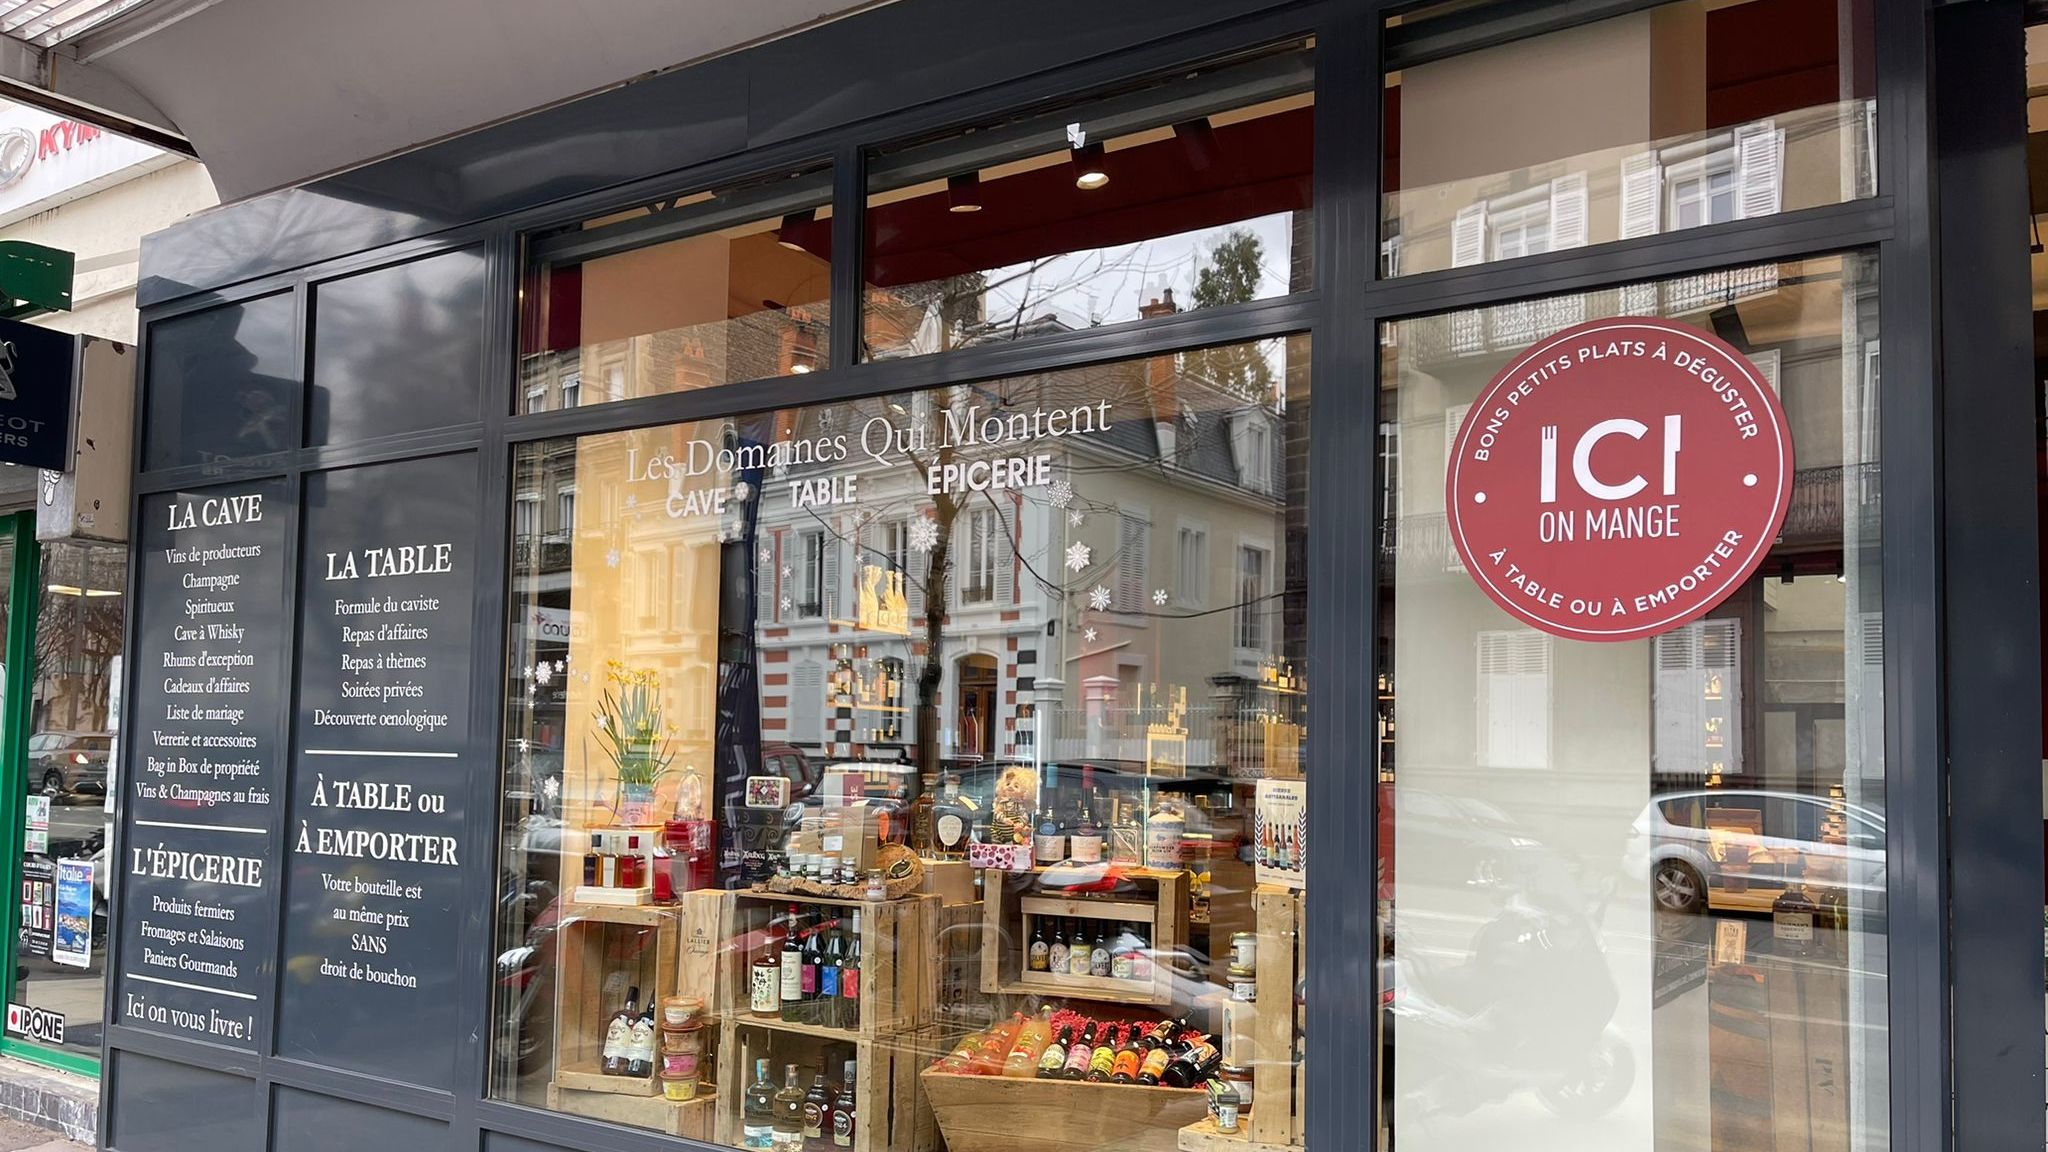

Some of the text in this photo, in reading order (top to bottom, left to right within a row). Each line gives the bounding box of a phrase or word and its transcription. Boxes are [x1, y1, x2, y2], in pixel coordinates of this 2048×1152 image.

[1474, 341, 1758, 462] BONS PETITS PLATS À DÉGUSTER
[626, 398, 1113, 483] Les Domaines Qui Montent
[1540, 414, 1682, 504] ICI
[666, 454, 1051, 518] CAVE TABLE ÉPICERIE
[168, 494, 262, 530] LA CAVE
[1540, 504, 1681, 543] ON MANGE
[166, 544, 261, 566] Vins de producteurs
[325, 543, 452, 580] LA TABLE
[183, 573, 240, 592] Champagne
[1489, 529, 1744, 616] À TABLE OU À EMPORTER
[185, 598, 235, 619] Spiritueux
[335, 594, 439, 616] Formule du caviste
[174, 623, 245, 644] Cave à Whisky
[342, 623, 428, 647] Repas d'affaires
[163, 650, 254, 671] Rhums d'exception
[341, 652, 427, 675] Repas à thèmes
[164, 677, 250, 693] Cadeaux d'affaires
[342, 681, 424, 703] Soirées privées
[167, 704, 244, 725] Liste de mariage
[314, 709, 377, 726] Découverte
[152, 731, 257, 748] Verrerie et accessoires
[147, 757, 260, 780] Bag in Box de propriété
[136, 782, 270, 807] Vins & Champagnes au frais
[311, 773, 445, 814] À TABLE ou
[295, 819, 459, 866] À EMPORTER
[132, 842, 262, 887] L'ÉPICERIE
[321, 873, 423, 900] Votre bouteille est
[153, 895, 235, 921] Produits fermiers
[333, 905, 410, 931] au même prix
[141, 920, 245, 950] Fromages et Salaisons
[352, 933, 387, 954] SANS
[144, 948, 238, 978] Paniers Gourmands
[320, 958, 417, 988] droit de bouchon
[20, 1009, 62, 1040] IPONE
[126, 993, 253, 1041] Ici on vous livre !
